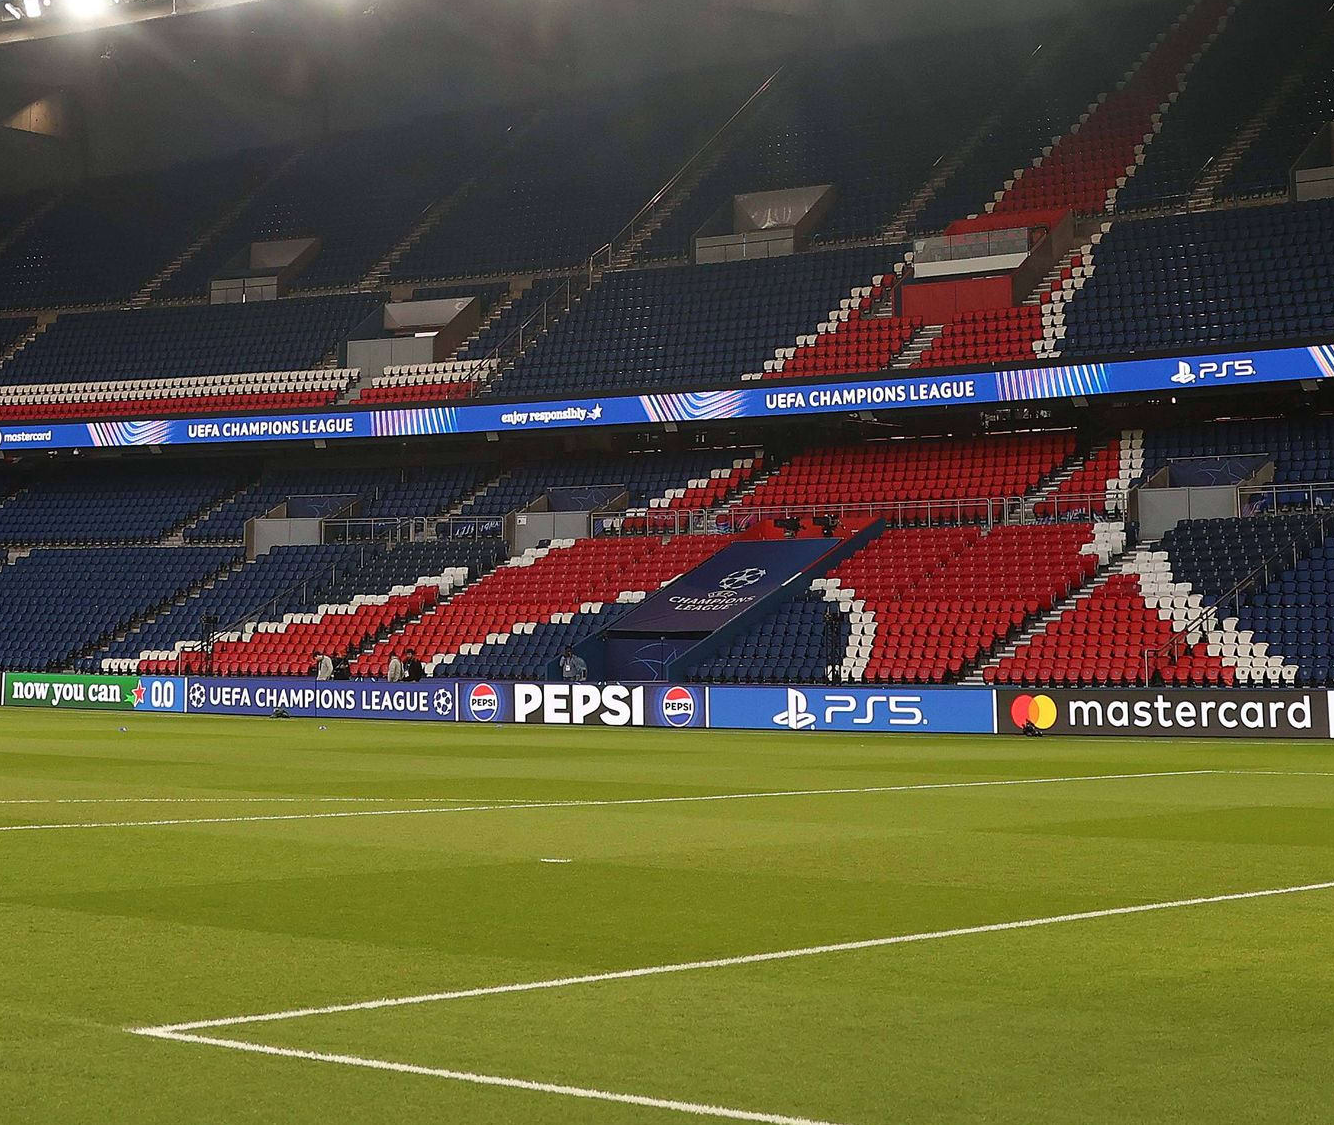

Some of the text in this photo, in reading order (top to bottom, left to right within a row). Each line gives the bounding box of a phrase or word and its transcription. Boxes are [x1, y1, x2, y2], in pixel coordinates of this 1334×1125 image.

[1199, 360, 1253, 379] PS5
[765, 381, 975, 410] UEFA CHAMPIONS LEAGUE
[501, 407, 587, 425] enjoy responsibly
[4, 430, 52, 443] mastercard
[188, 418, 354, 438] UEFA CHAMPIONS LEAGUE
[668, 595, 756, 606] CHAMPIONS
[12, 682, 121, 706] now you can
[209, 687, 429, 712] UEFA CHAMPIONS LEAGUE
[471, 698, 496, 707] PEPSI
[514, 683, 644, 726] PEPSI
[664, 701, 692, 711] PEPSI
[824, 695, 923, 725] PS5
[1068, 694, 1312, 730] mastercard
